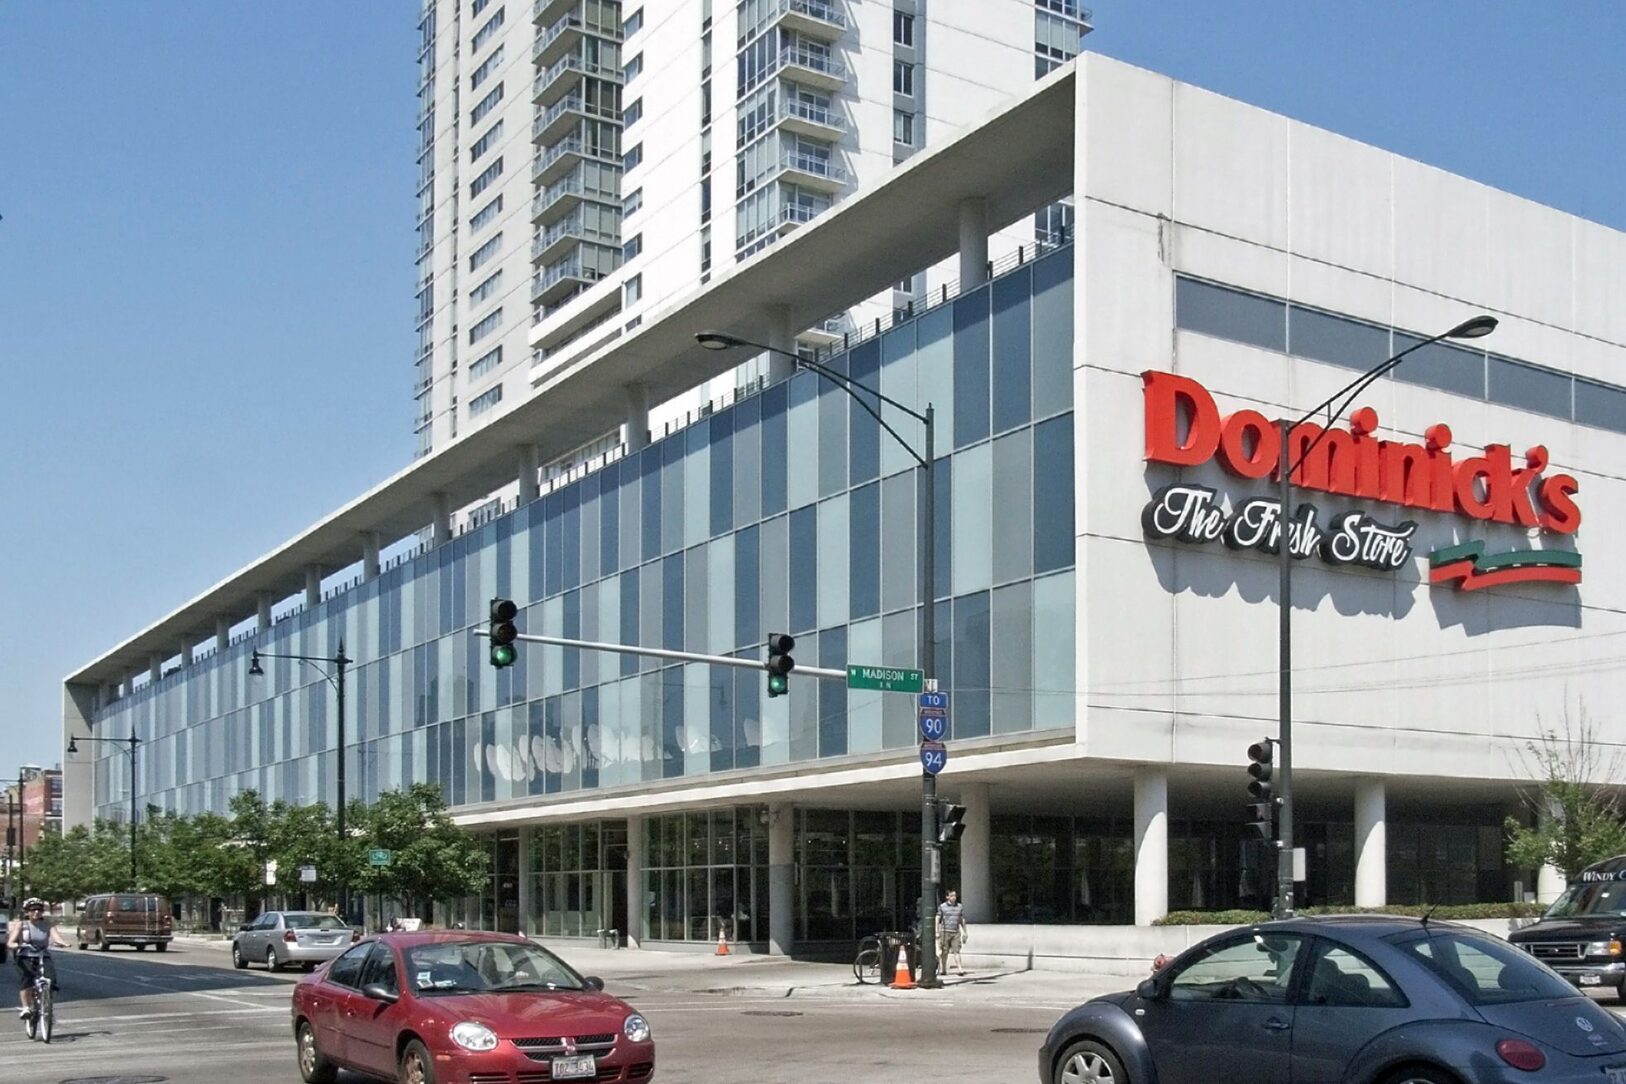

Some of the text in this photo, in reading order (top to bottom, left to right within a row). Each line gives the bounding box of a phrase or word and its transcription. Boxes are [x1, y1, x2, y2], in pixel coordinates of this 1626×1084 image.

[1141, 370, 1581, 534] Dominick's
[1154, 487, 1414, 567] The Frsh Store
[862, 668, 904, 681] MADISON
[928, 695, 940, 705] TO
[926, 718, 942, 734] 90
[925, 751, 942, 767] 94
